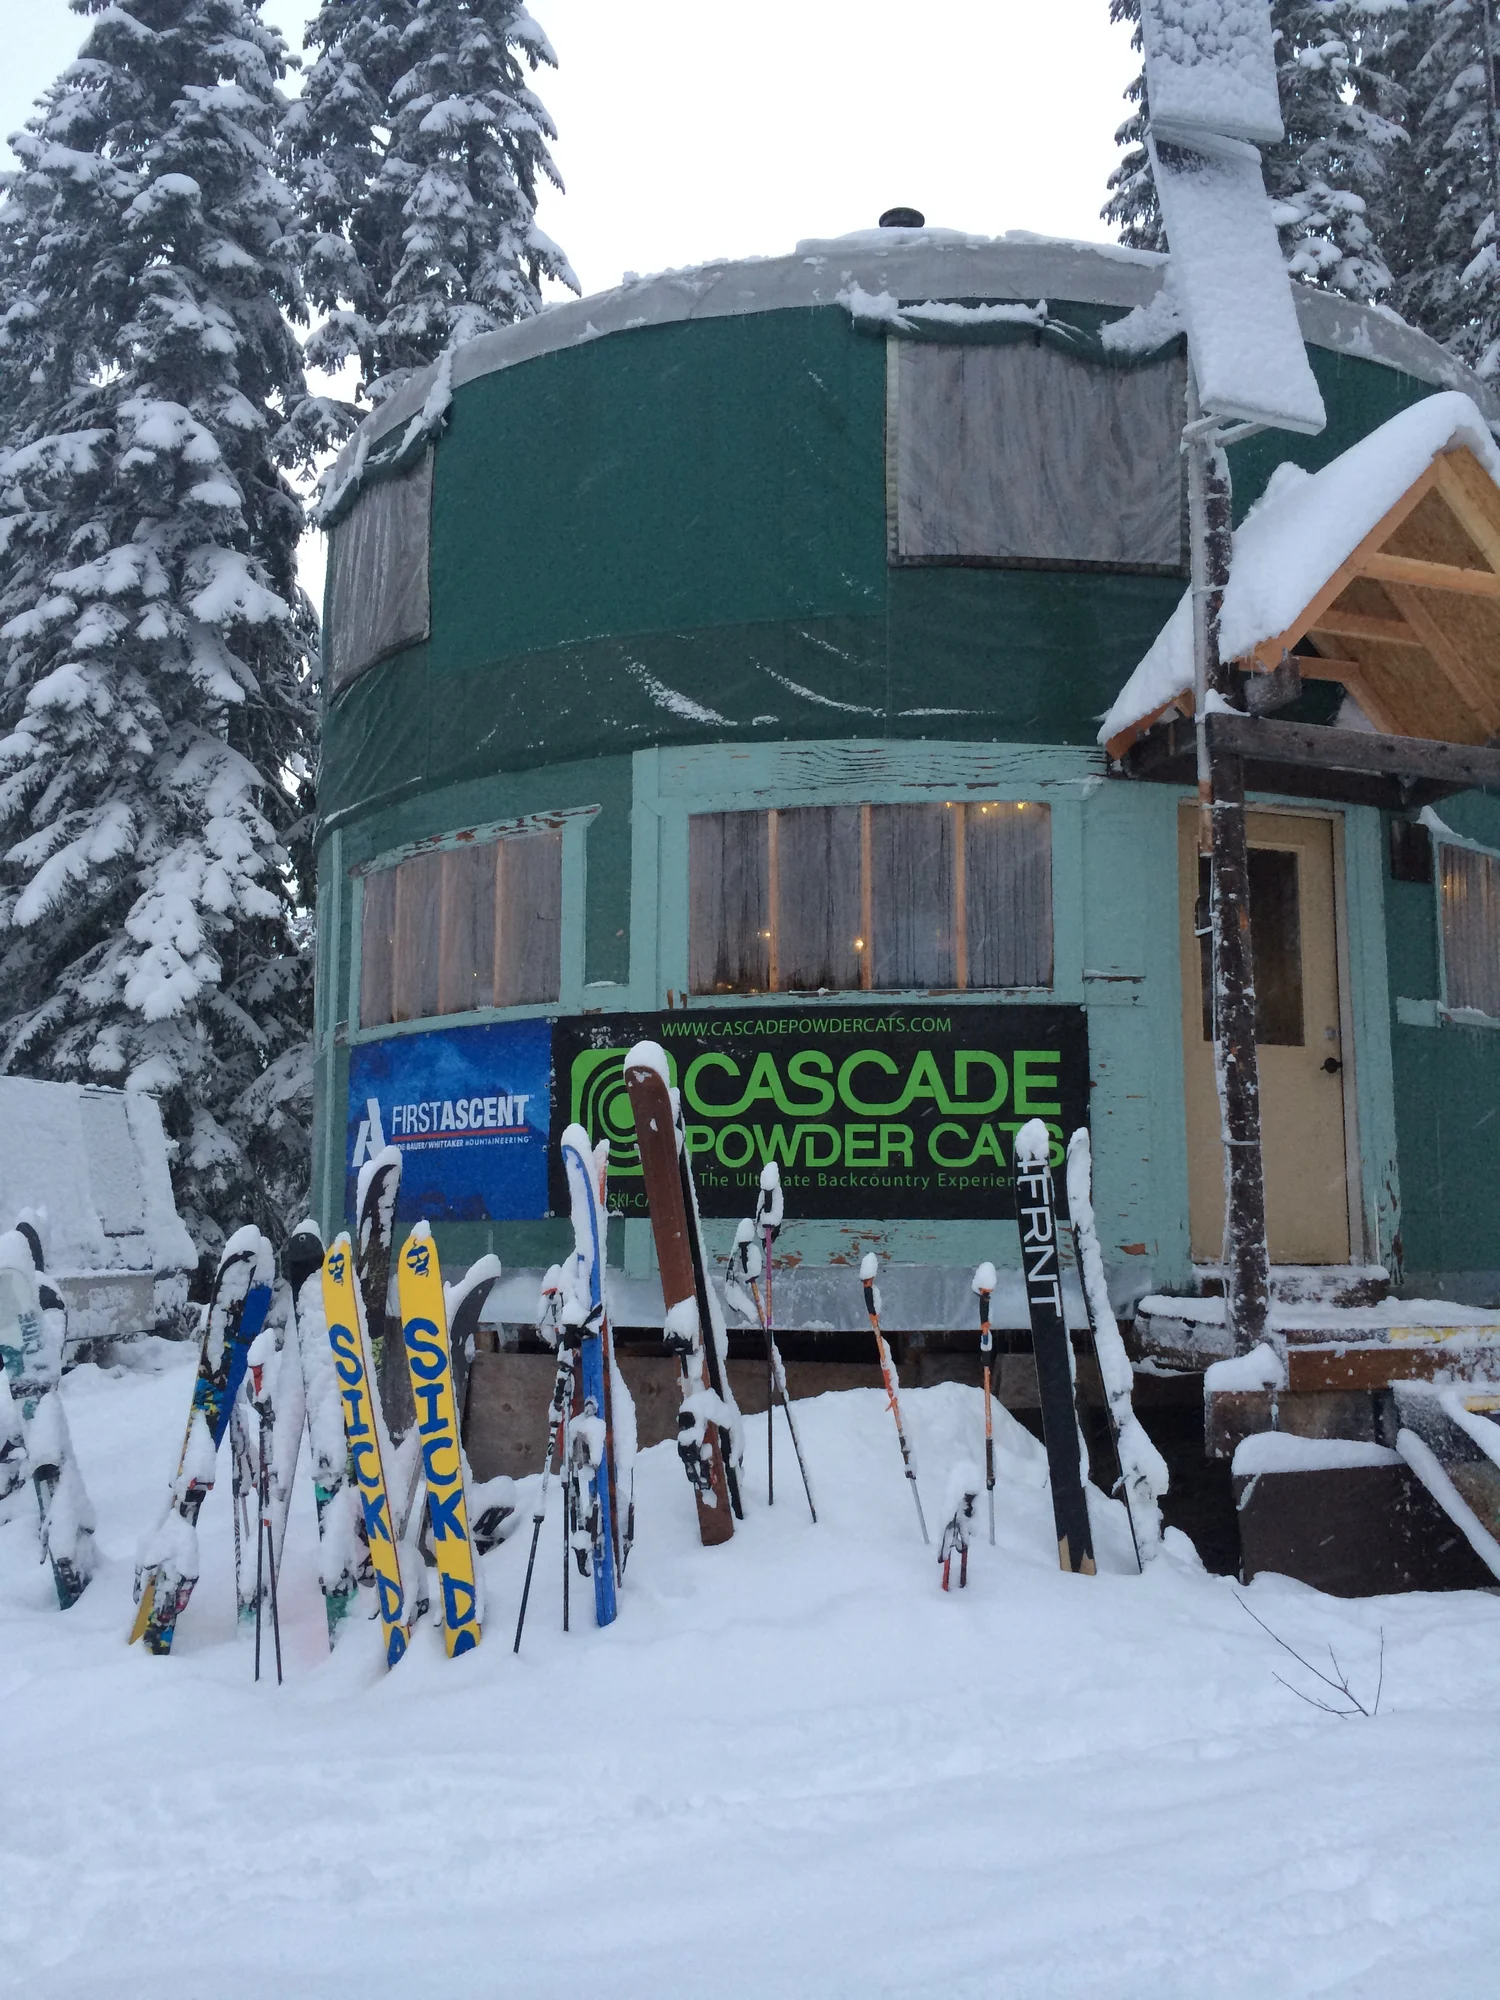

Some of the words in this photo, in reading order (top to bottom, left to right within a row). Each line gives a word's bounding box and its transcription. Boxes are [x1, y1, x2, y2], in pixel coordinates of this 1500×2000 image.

[661, 1017, 952, 1037] WWW.CASCADEPOWDERCATS.COM
[684, 1049, 1062, 1118] CASCADE
[685, 1123, 914, 1169] POWDER
[609, 1193, 649, 1208] SKI-C
[699, 1172, 729, 1187] The
[736, 1172, 811, 1187] Ultate
[818, 1172, 930, 1190] Backcountry
[938, 1172, 1015, 1190] Experien
[328, 1323, 393, 1545] SICK
[403, 1317, 468, 1542] SICK
